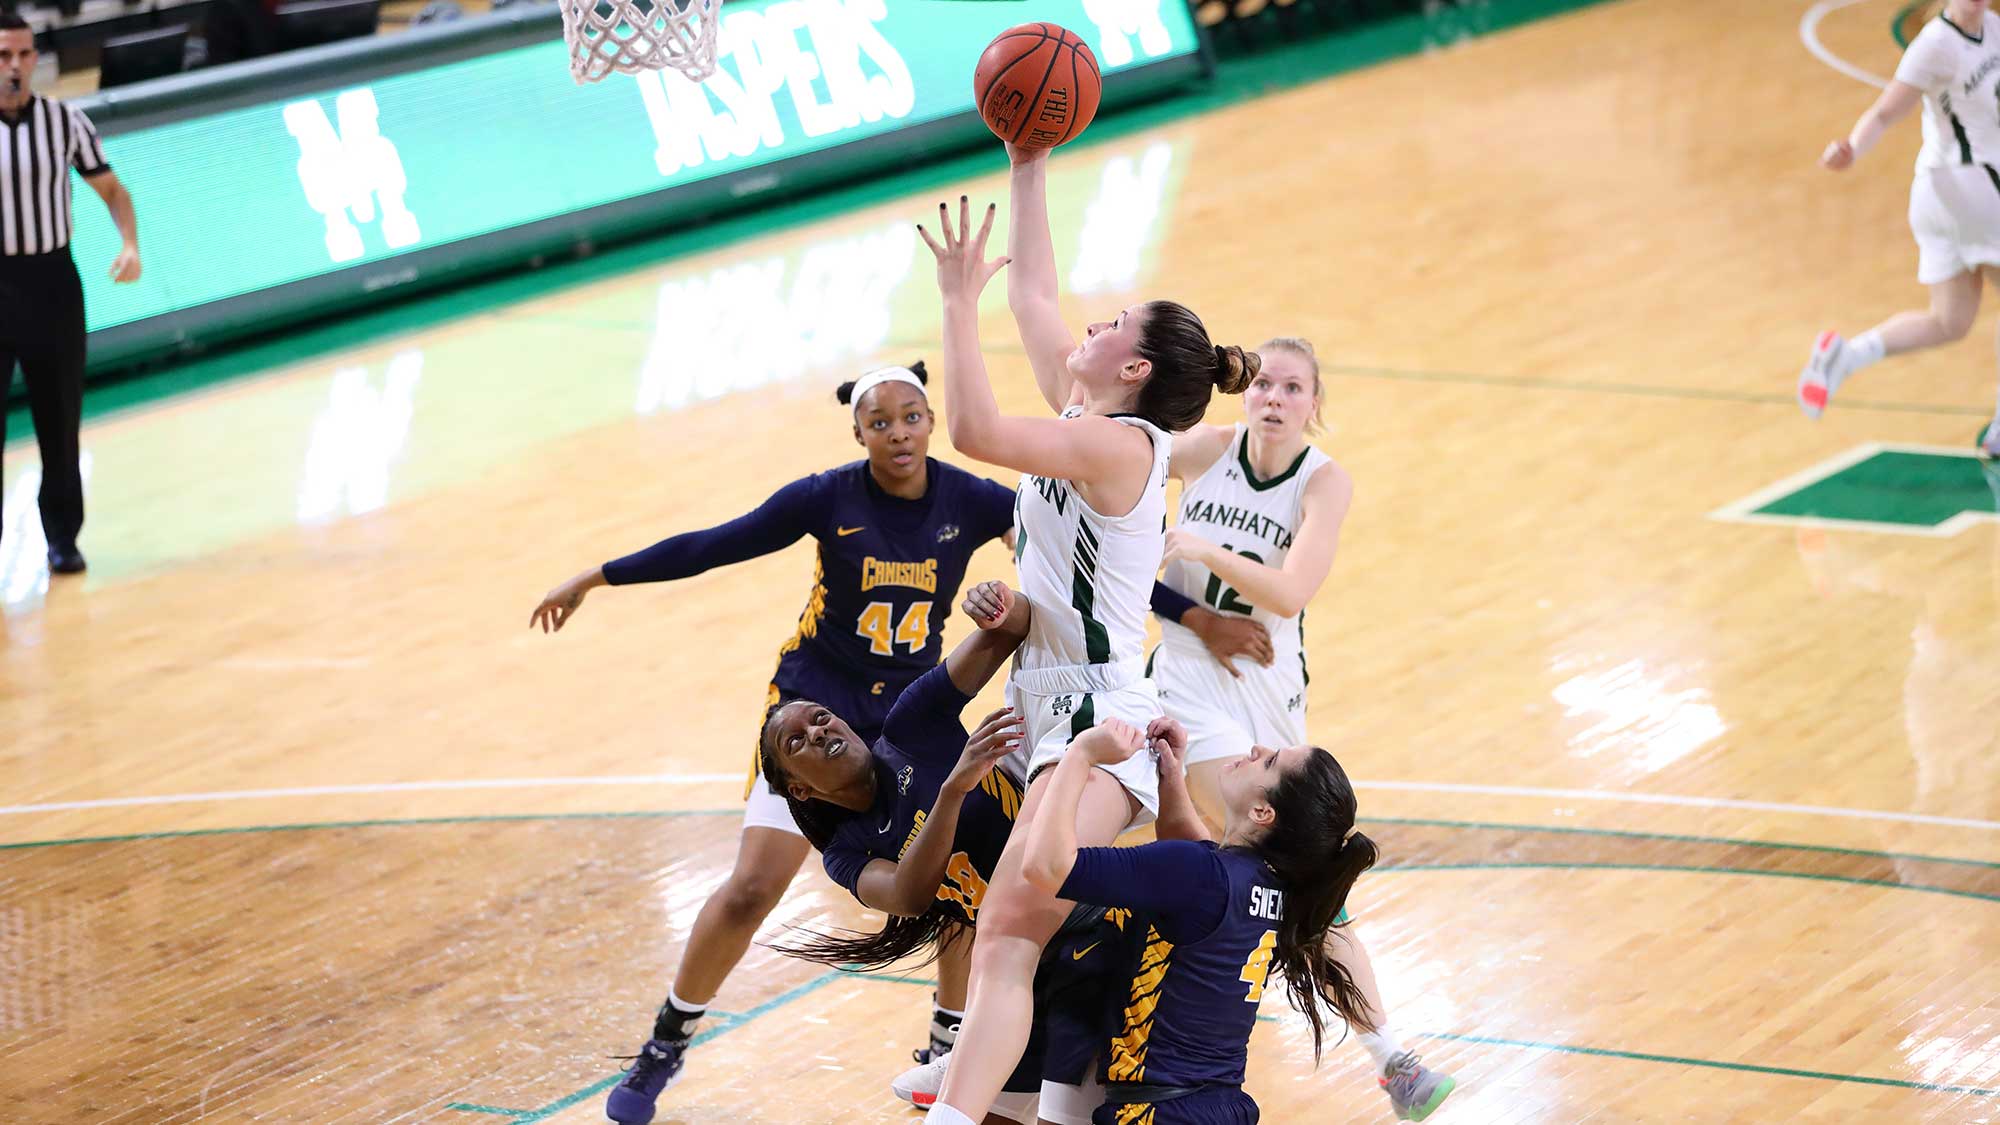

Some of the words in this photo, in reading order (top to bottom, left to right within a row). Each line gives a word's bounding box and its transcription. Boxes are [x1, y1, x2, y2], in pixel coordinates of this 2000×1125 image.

[1039, 87, 1067, 124] THE
[1181, 499, 1295, 551] MANHATTA
[861, 555, 938, 594] CANISIUS
[856, 600, 934, 657] 44
